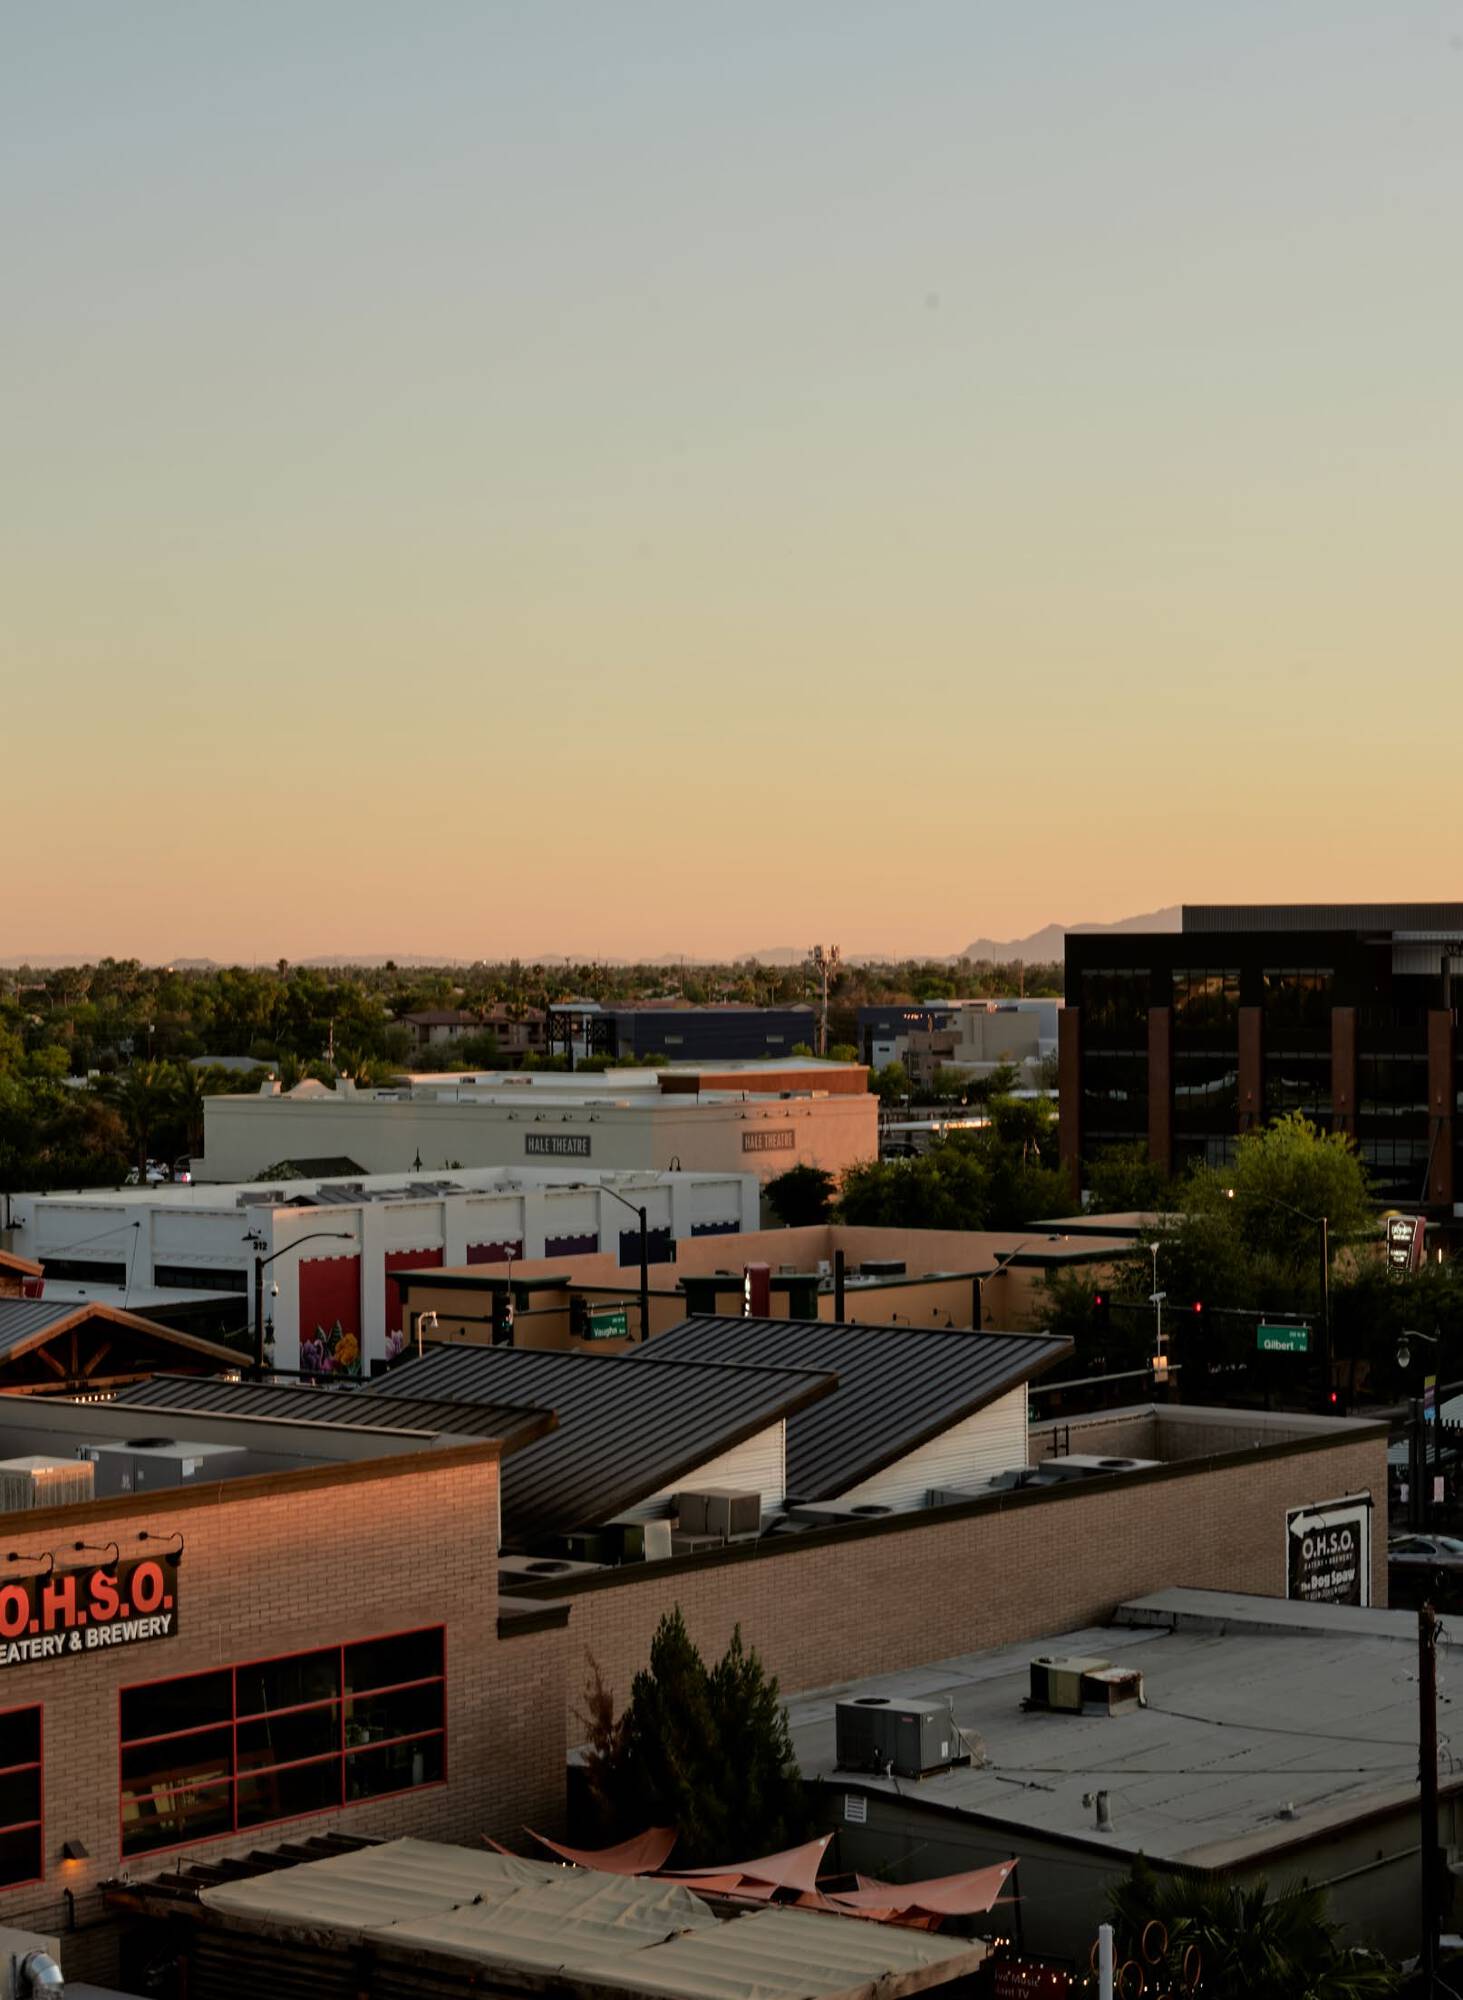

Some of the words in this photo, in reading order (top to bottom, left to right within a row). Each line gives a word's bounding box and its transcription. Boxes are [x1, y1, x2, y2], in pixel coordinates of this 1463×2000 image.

[528, 1137, 550, 1153] HALE
[552, 1138, 587, 1153] THEATRE
[745, 1134, 762, 1150] HALE
[764, 1132, 793, 1149] THEATRE
[253, 1241, 267, 1250] 312
[593, 1326, 618, 1338] Vaughn
[1264, 1339, 1294, 1350] Gilbert
[1302, 1530, 1354, 1559] O.H.S.O.
[1311, 1573, 1330, 1589] Dog
[1331, 1568, 1356, 1585] Spaw
[0, 1561, 173, 1638] O.H.S.O.
[0, 1633, 66, 1665] EATERY
[69, 1630, 82, 1651] &
[86, 1613, 172, 1648] BREWERY
